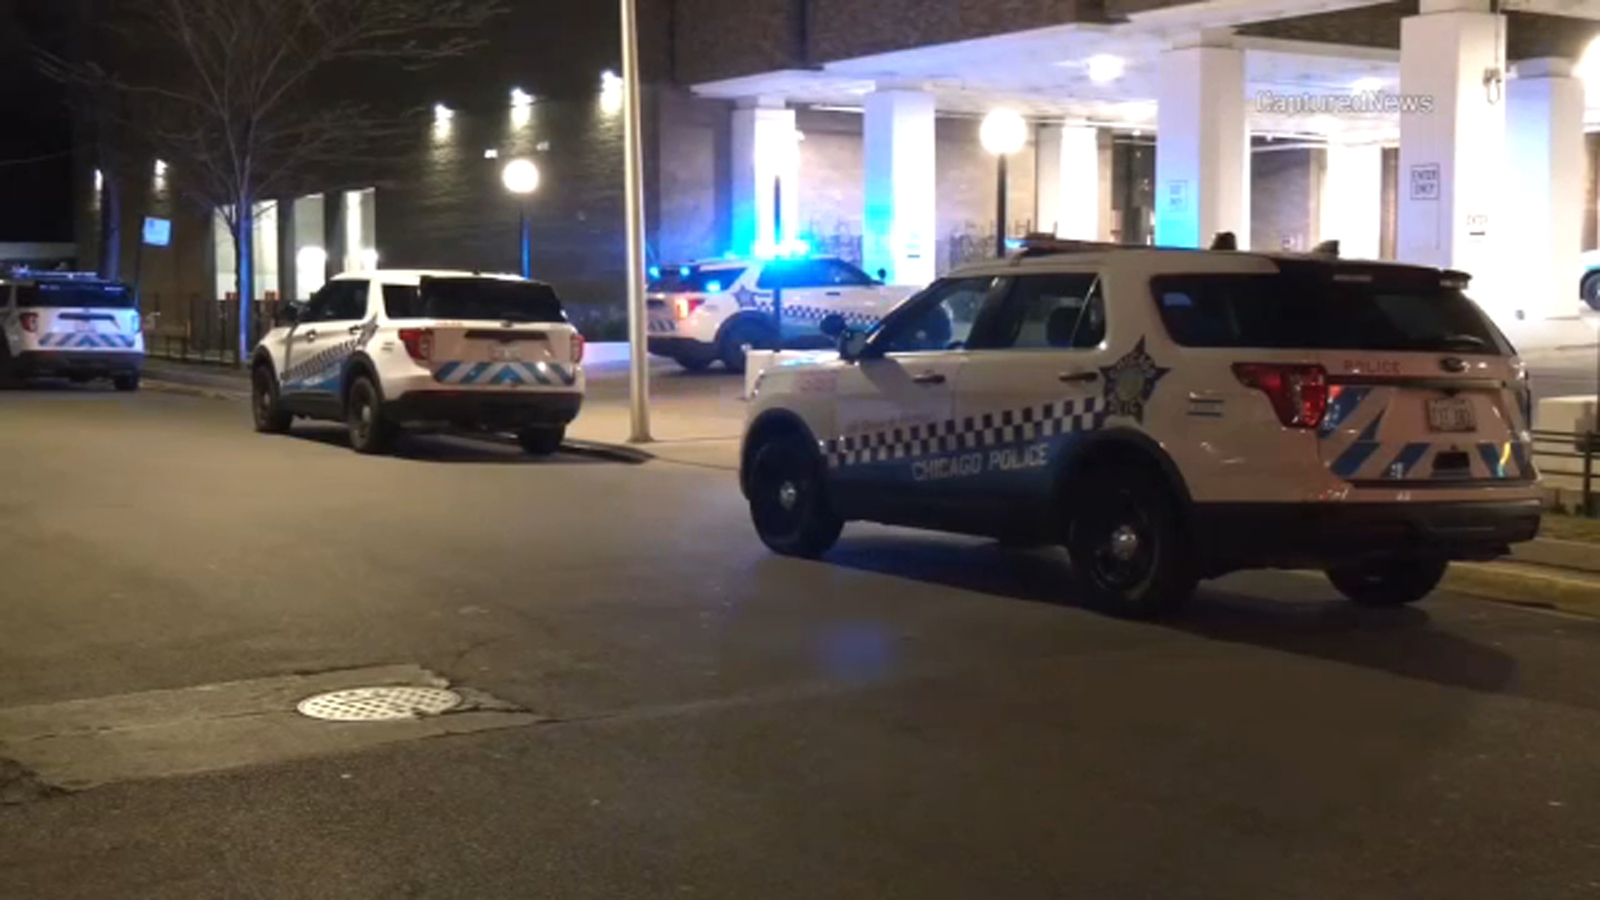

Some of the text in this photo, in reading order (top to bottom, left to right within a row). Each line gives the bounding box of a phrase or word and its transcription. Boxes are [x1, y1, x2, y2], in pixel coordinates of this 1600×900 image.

[1343, 360, 1400, 373] POLICE
[912, 443, 1049, 481] CHICAGO POLICE
